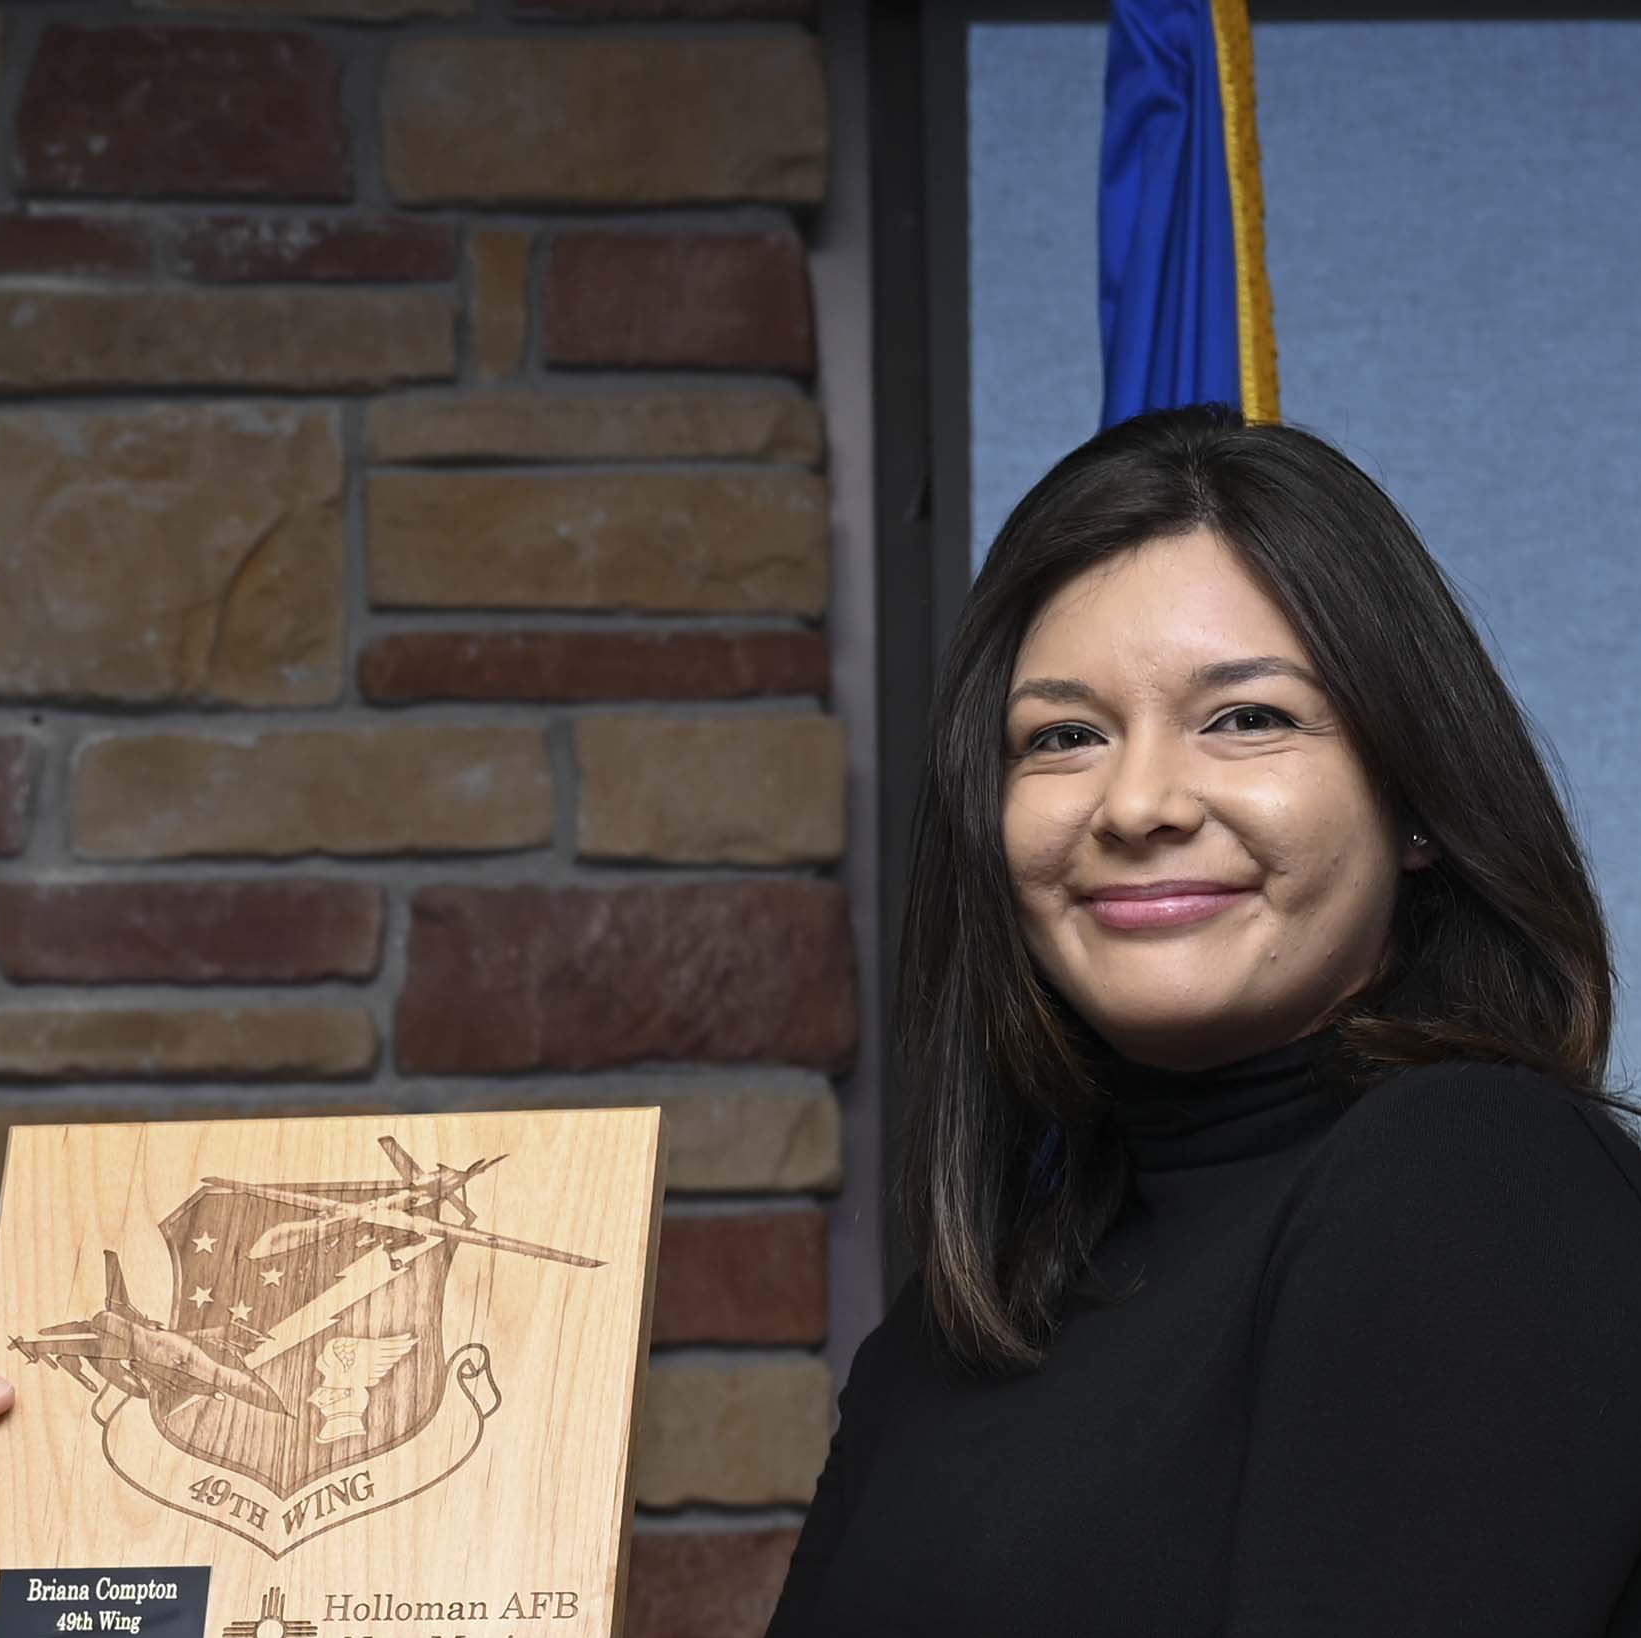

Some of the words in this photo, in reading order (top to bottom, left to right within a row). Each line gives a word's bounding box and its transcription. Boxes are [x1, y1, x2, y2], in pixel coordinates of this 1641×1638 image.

[188, 1474, 269, 1532] 49TH
[281, 1469, 375, 1536] WING
[26, 1578, 90, 1602] Briana
[95, 1577, 178, 1605] Compton
[322, 1593, 489, 1622] Holloman
[499, 1591, 580, 1620] AFB
[56, 1611, 93, 1631] 49th
[99, 1610, 142, 1634] Wing
